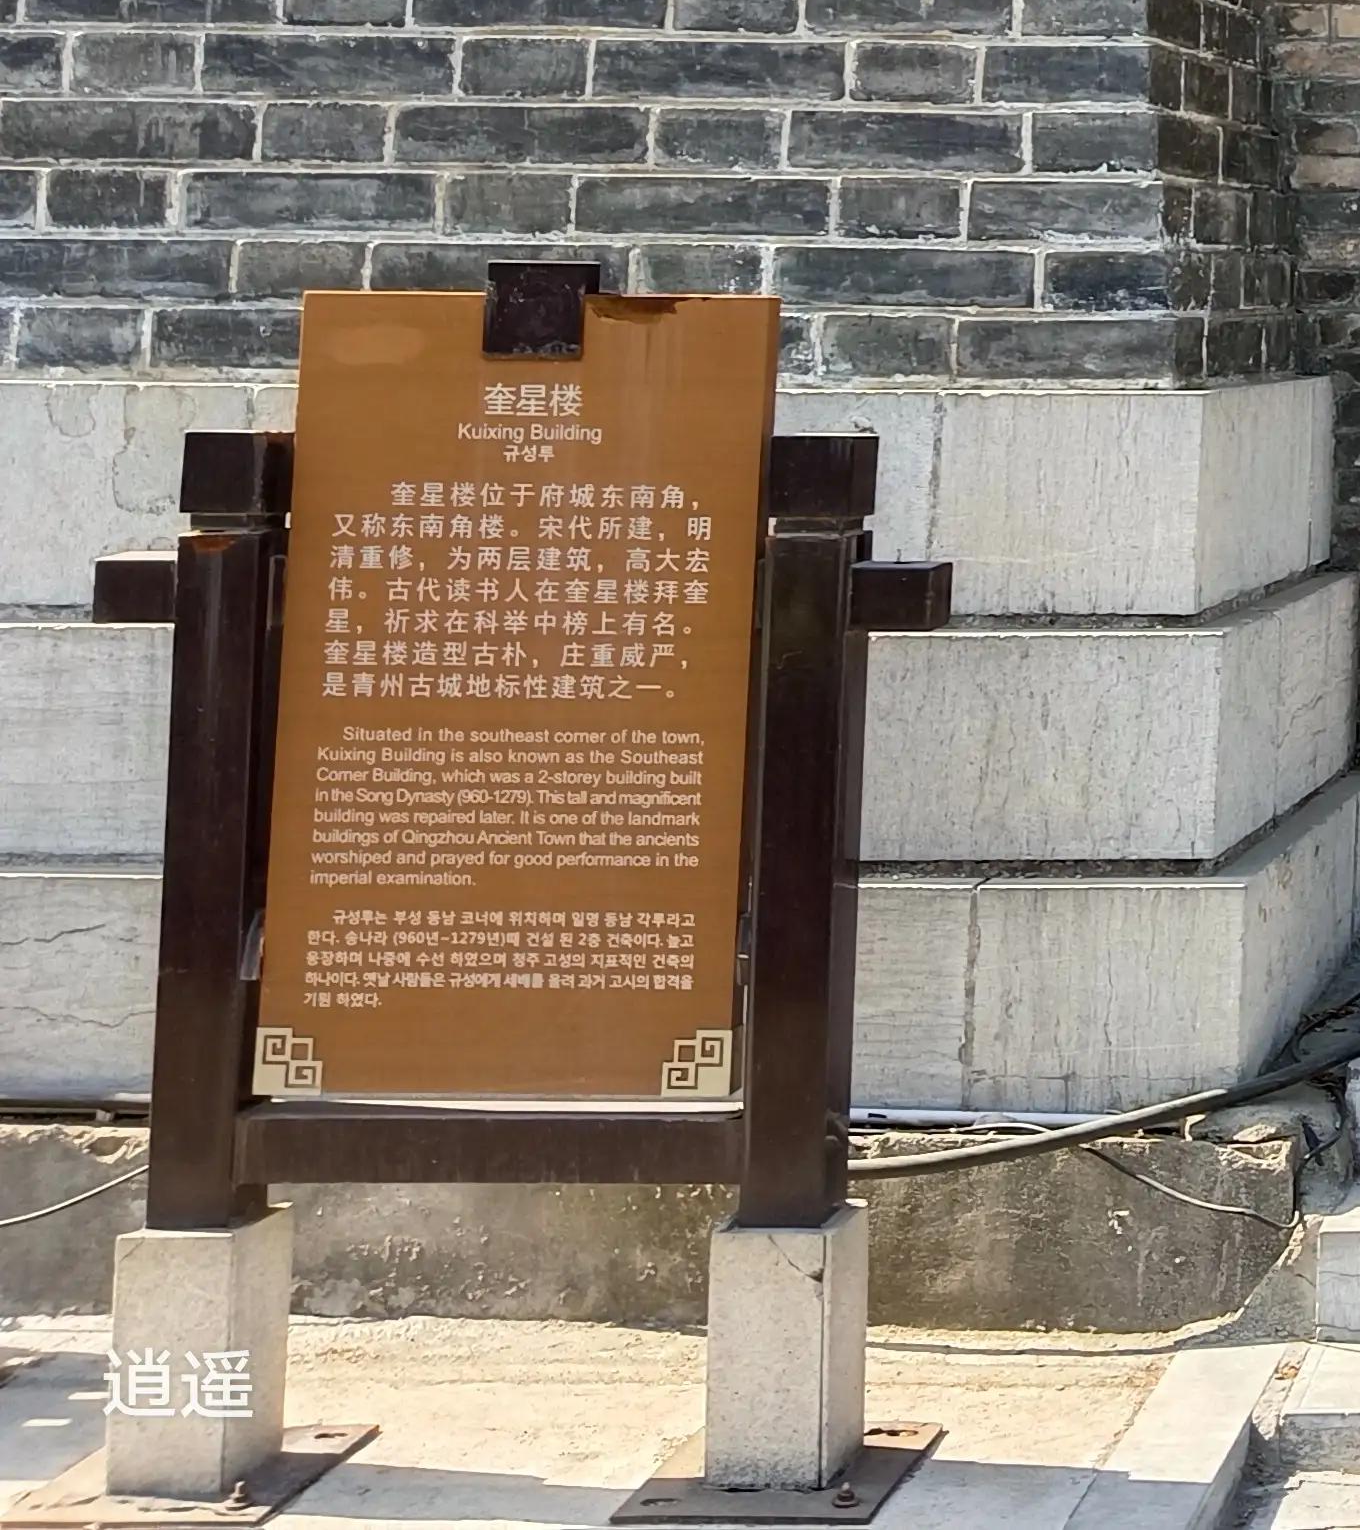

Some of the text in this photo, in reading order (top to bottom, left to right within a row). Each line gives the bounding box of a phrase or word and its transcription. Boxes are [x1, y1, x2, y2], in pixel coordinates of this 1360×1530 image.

[483, 381, 583, 417] 奎星楼
[457, 422, 603, 445] Kuixing Building
[390, 481, 699, 511] 奎星楼位于府城东南角，
[331, 512, 712, 542] 又称东南角楼。宋代所建，明
[329, 544, 710, 573] 清重修，为两层建筑，高大宏
[327, 575, 710, 605] 伟。古代读书人在奎星楼拜奎
[324, 607, 692, 637] 星，祈求在科举中榜上有名。
[323, 639, 688, 670] 奎星楼造型古朴，庄重威严，
[321, 671, 675, 700] 是青州古城地标性建筑之一。
[342, 725, 705, 746] Situated in the southeast corner of the town,
[317, 746, 704, 766] Kuixing Building is also known as the Southeast
[316, 766, 369, 782] Corner
[441, 768, 486, 784] which
[489, 772, 521, 784] was
[524, 772, 534, 784] a
[537, 769, 602, 788] 2-storey
[605, 770, 666, 789] building
[670, 770, 702, 786] built
[315, 787, 329, 802] in
[330, 787, 354, 803] the
[355, 787, 394, 807] Song
[396, 787, 455, 807] Dynasty
[535, 789, 566, 805] This
[566, 790, 588, 805] tall
[589, 790, 617, 805] and
[618, 790, 702, 809] magnificent
[313, 807, 701, 827] building was repaired later. It is one of the landmark
[312, 828, 700, 848] buildings of Qingzhou Ancient Town that the ancients
[311, 849, 700, 870] worshiped and prayed for good performance in the
[309, 869, 476, 886] imperial examination.
